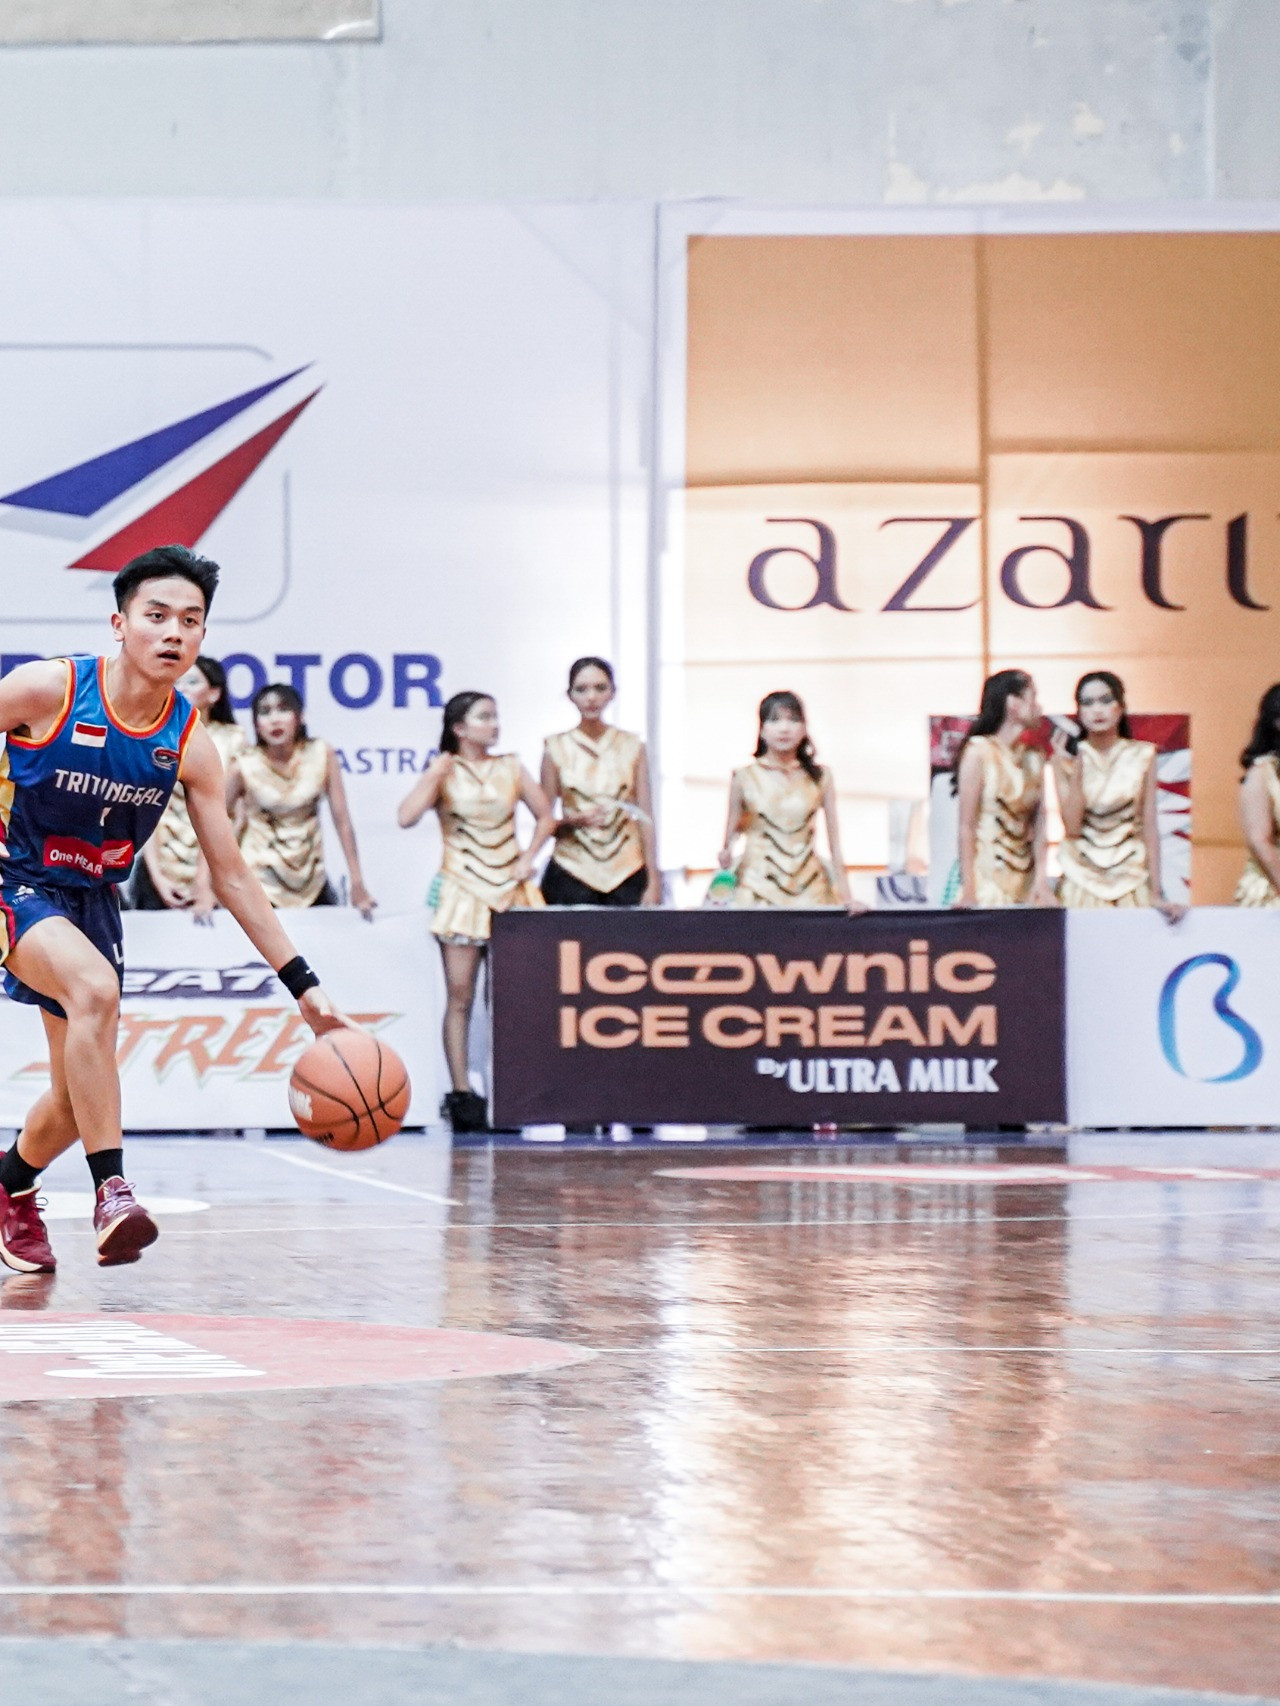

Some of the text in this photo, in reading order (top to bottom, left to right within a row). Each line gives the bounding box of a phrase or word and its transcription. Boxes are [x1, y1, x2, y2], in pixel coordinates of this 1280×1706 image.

[747, 512, 1280, 612] azari
[221, 652, 444, 709] OTOR
[50, 849, 103, 875] One HEAR
[560, 1005, 999, 1049] ICE CREAM
[756, 1058, 999, 1094] By ULTRA MILK
